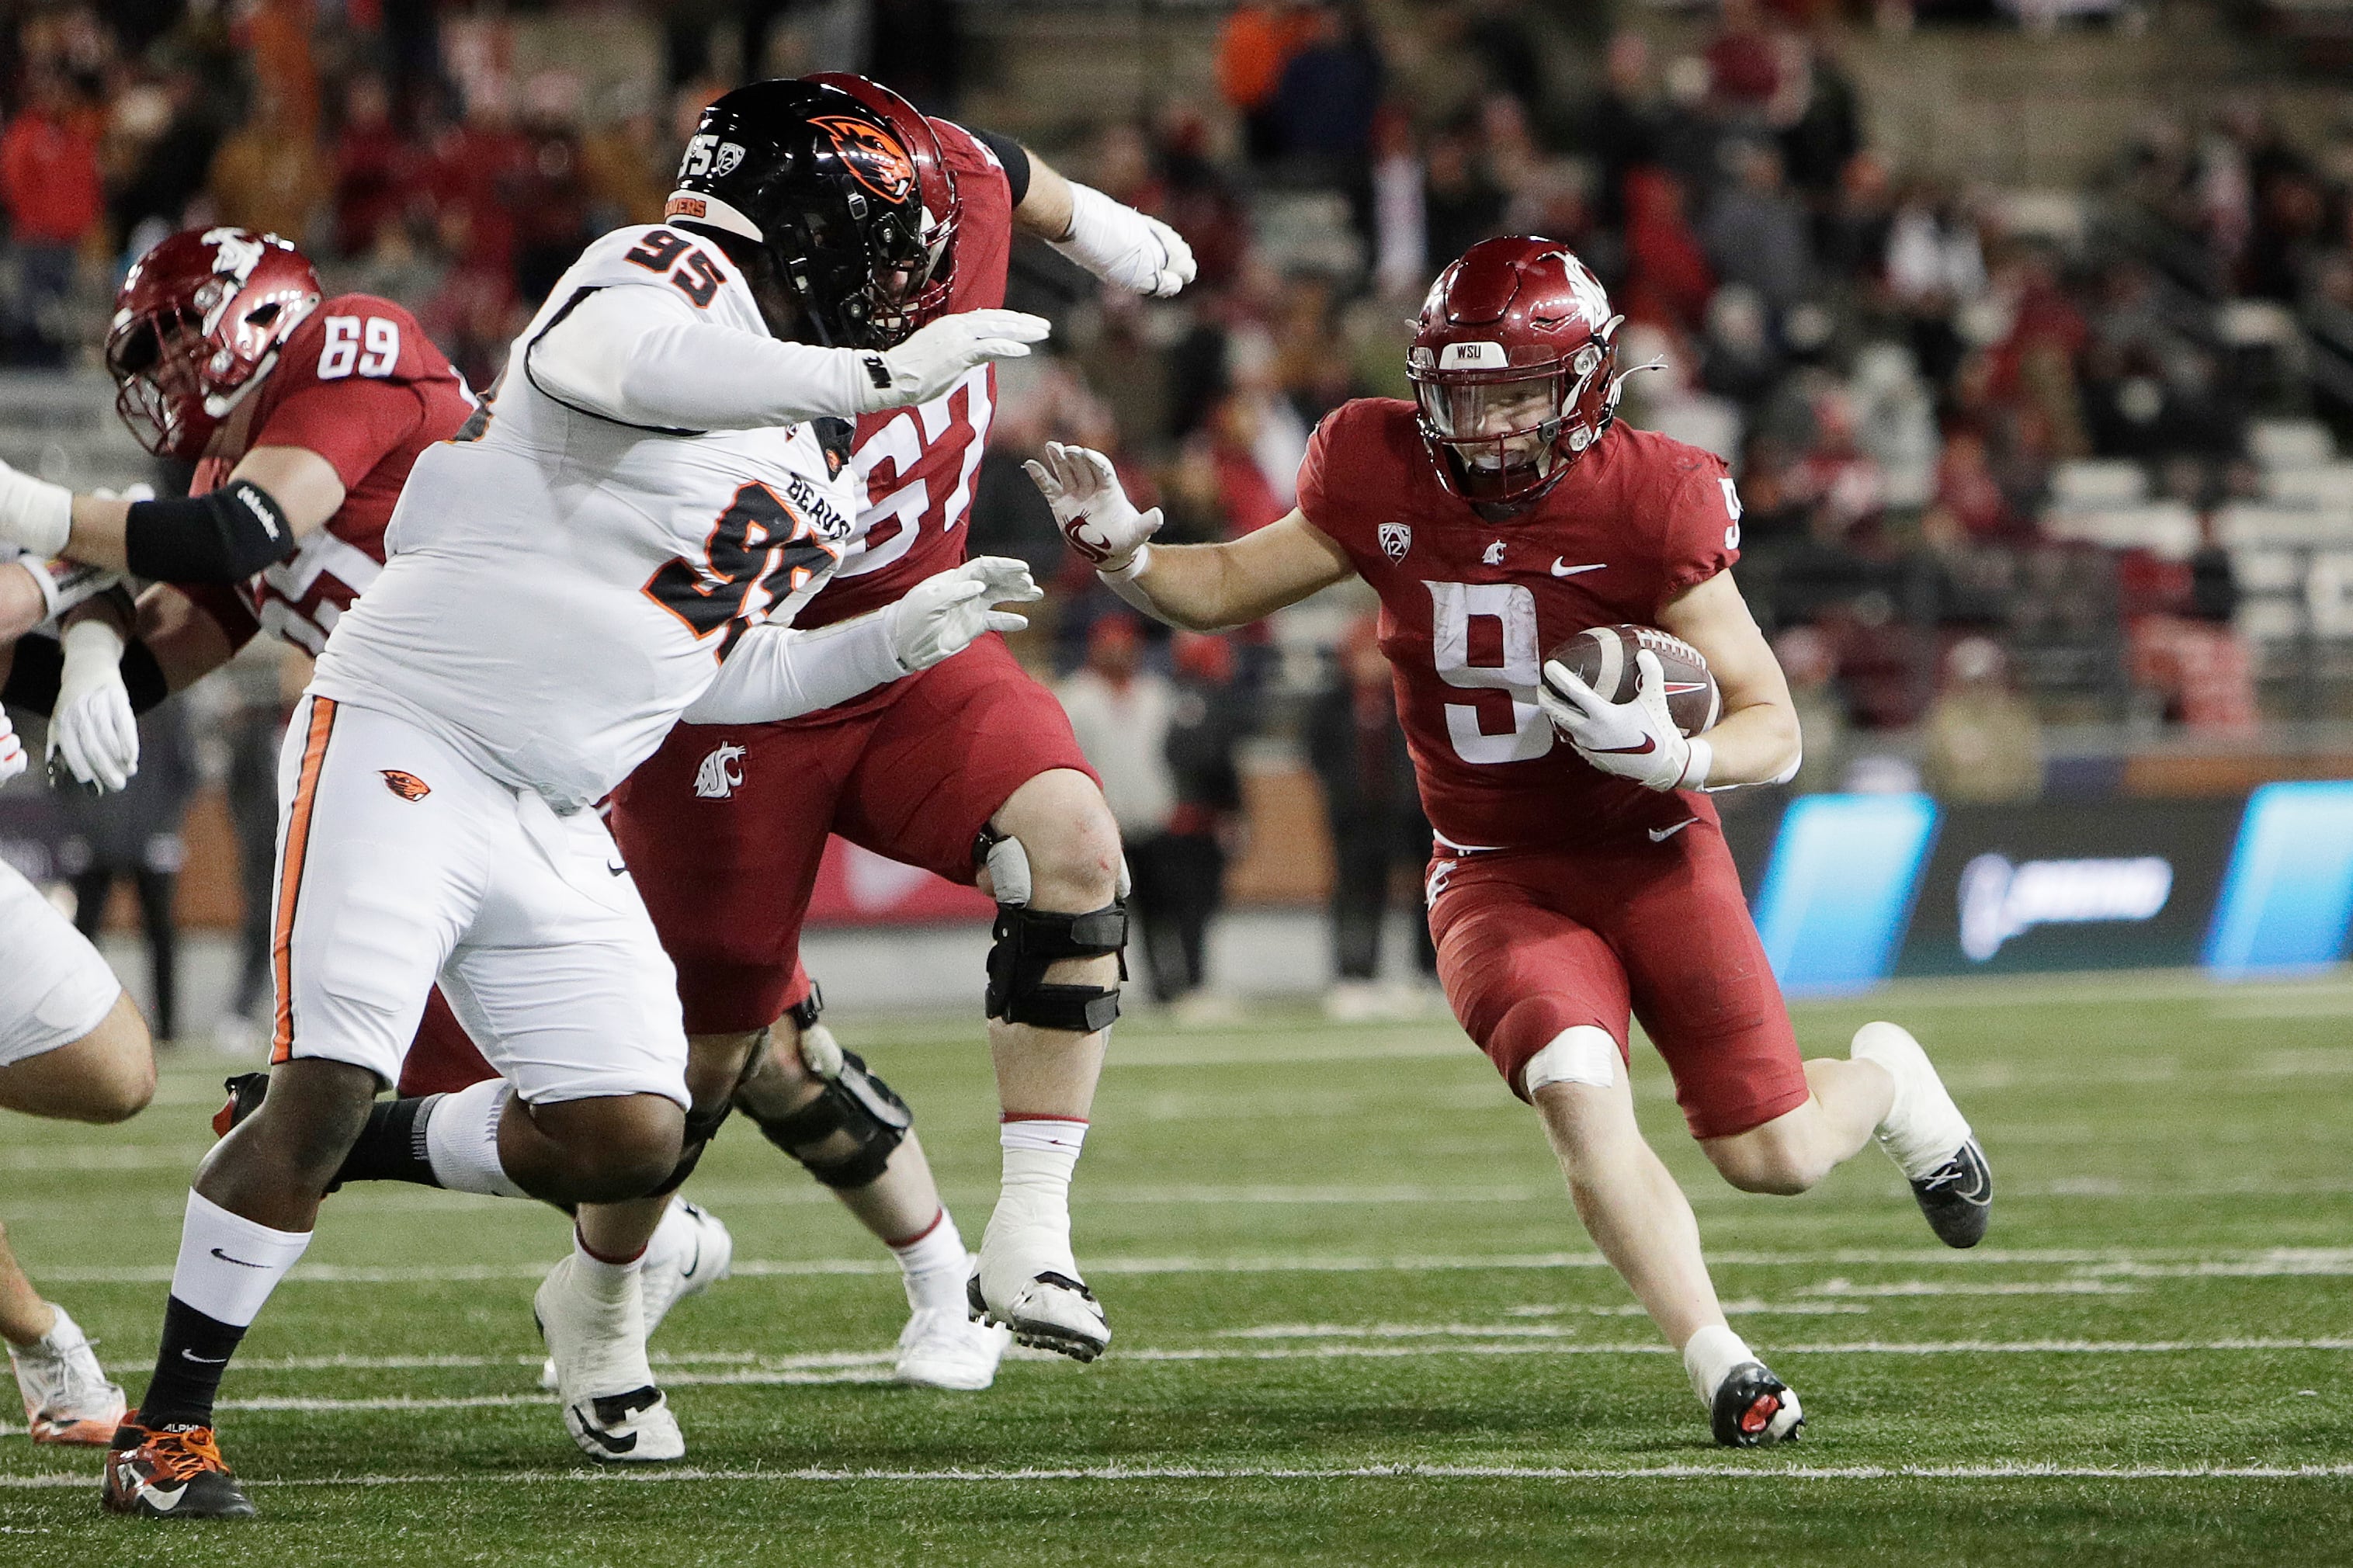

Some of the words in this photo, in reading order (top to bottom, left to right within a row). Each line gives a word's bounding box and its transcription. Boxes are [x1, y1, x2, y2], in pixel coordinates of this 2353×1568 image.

[623, 230, 727, 309] 95
[317, 315, 401, 380] 69
[1457, 345, 1481, 359] WSU
[833, 362, 992, 578] 67
[787, 471, 851, 540] BEAVS
[1716, 477, 1744, 550] 9
[1387, 540, 1403, 556] 12
[1420, 580, 1553, 765] 9
[162, 1423, 200, 1433] ALPH
